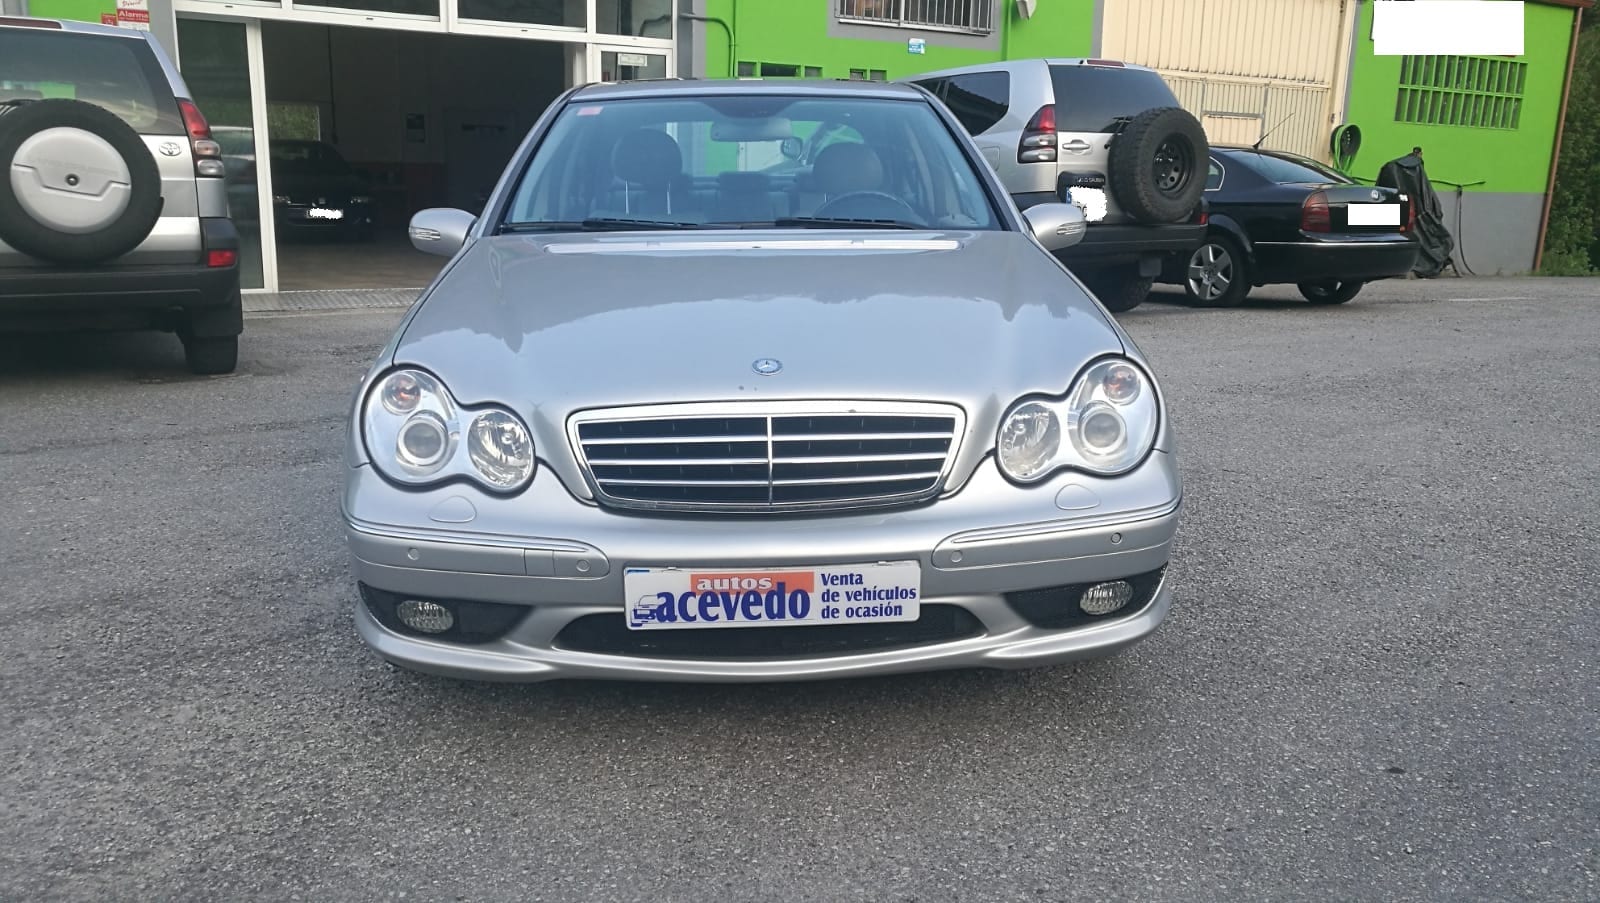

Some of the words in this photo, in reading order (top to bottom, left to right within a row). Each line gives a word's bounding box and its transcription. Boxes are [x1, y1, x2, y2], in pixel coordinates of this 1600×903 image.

[119, 10, 149, 19] Alarma
[696, 576, 773, 591] autos
[820, 572, 864, 586] Venta
[655, 581, 811, 622] acevedo
[821, 588, 840, 603] de
[845, 585, 917, 602] vehículos
[821, 604, 840, 619] de
[845, 601, 903, 618] ocasión
